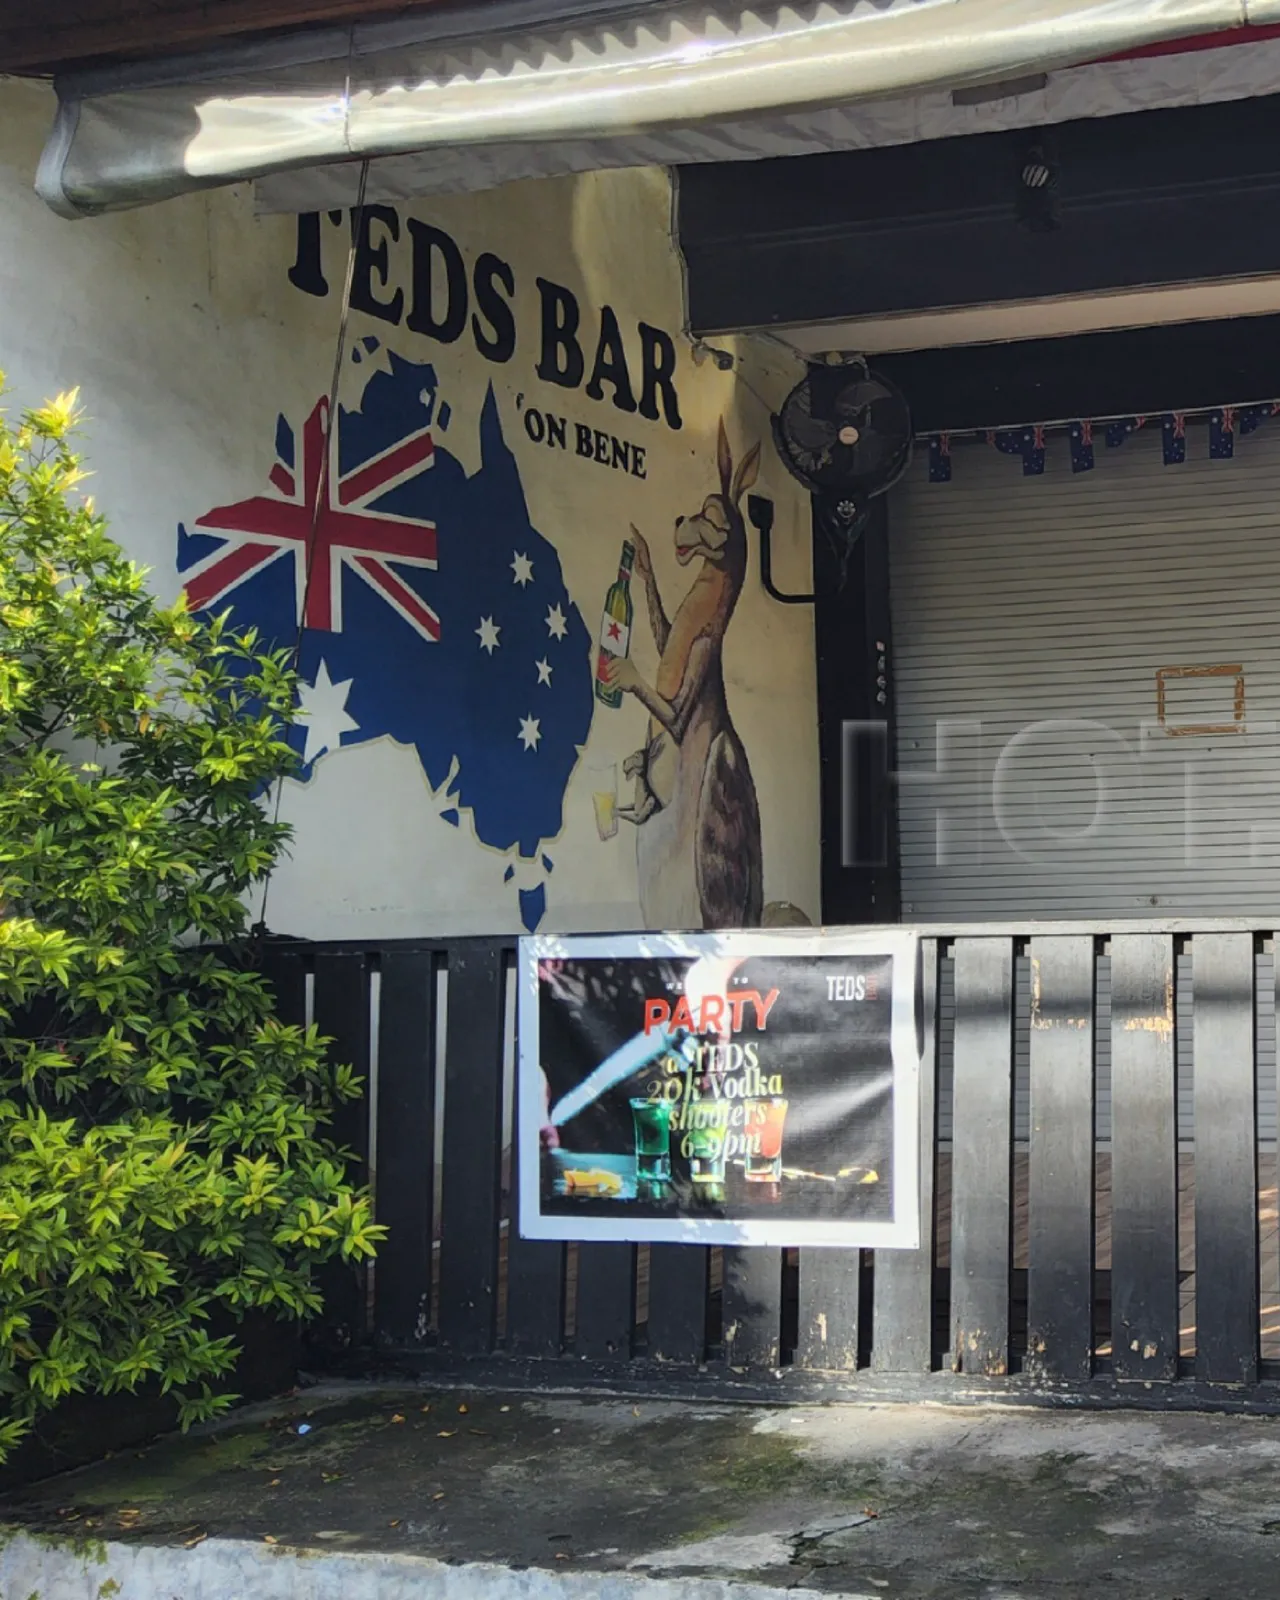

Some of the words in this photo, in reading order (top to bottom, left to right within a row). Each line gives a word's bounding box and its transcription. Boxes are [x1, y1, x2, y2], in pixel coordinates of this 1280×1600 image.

[288, 203, 516, 363] TEDS
[536, 276, 683, 431] BAR
[575, 423, 648, 480] BENE
[733, 976, 749, 985] TO
[826, 974, 866, 1001] TEDS
[644, 987, 780, 1036] PARTY
[710, 1067, 784, 1099] Vodka
[668, 1099, 768, 1131] shooters
[680, 1129, 762, 1163] 6-9pm
